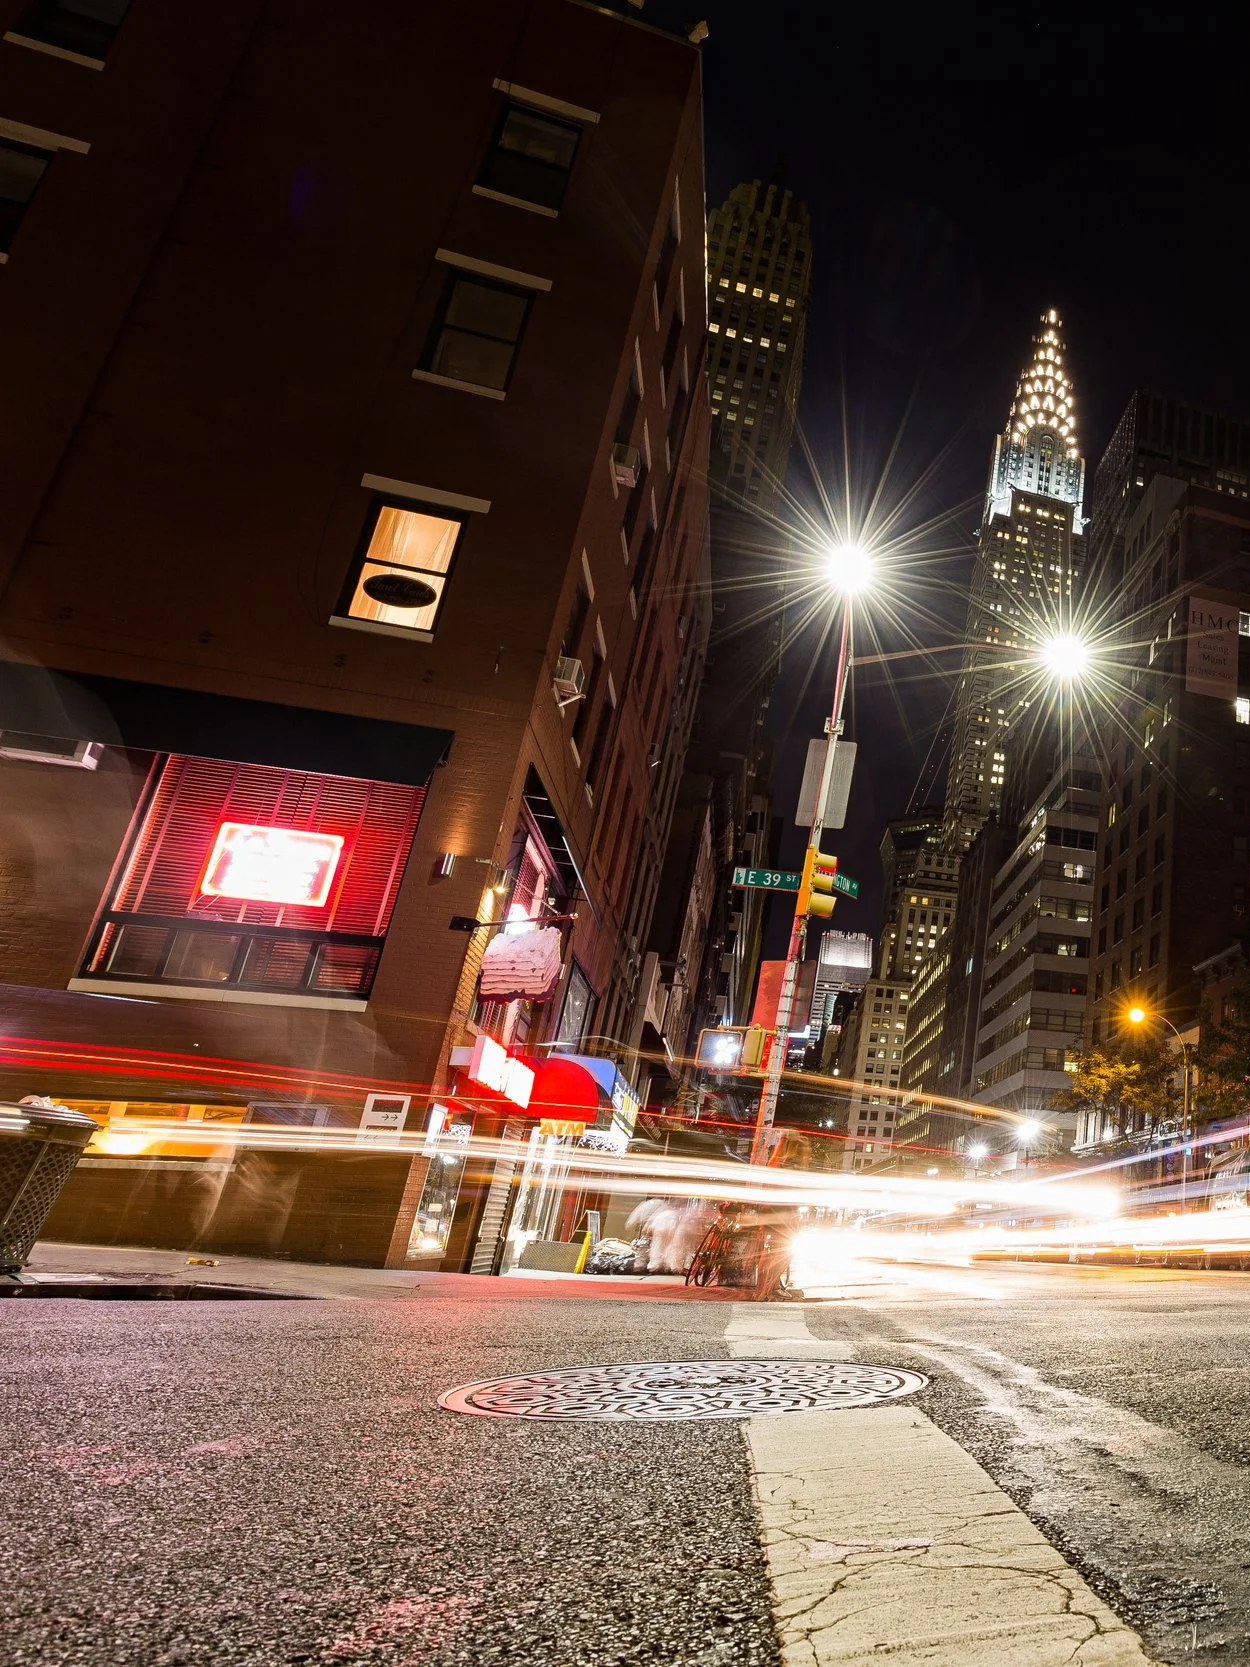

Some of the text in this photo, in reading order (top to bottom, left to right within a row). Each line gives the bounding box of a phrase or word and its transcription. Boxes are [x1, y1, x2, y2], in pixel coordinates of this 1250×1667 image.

[748, 871, 757, 885] E
[763, 873, 781, 886] 39
[539, 1120, 586, 1137] ATM
